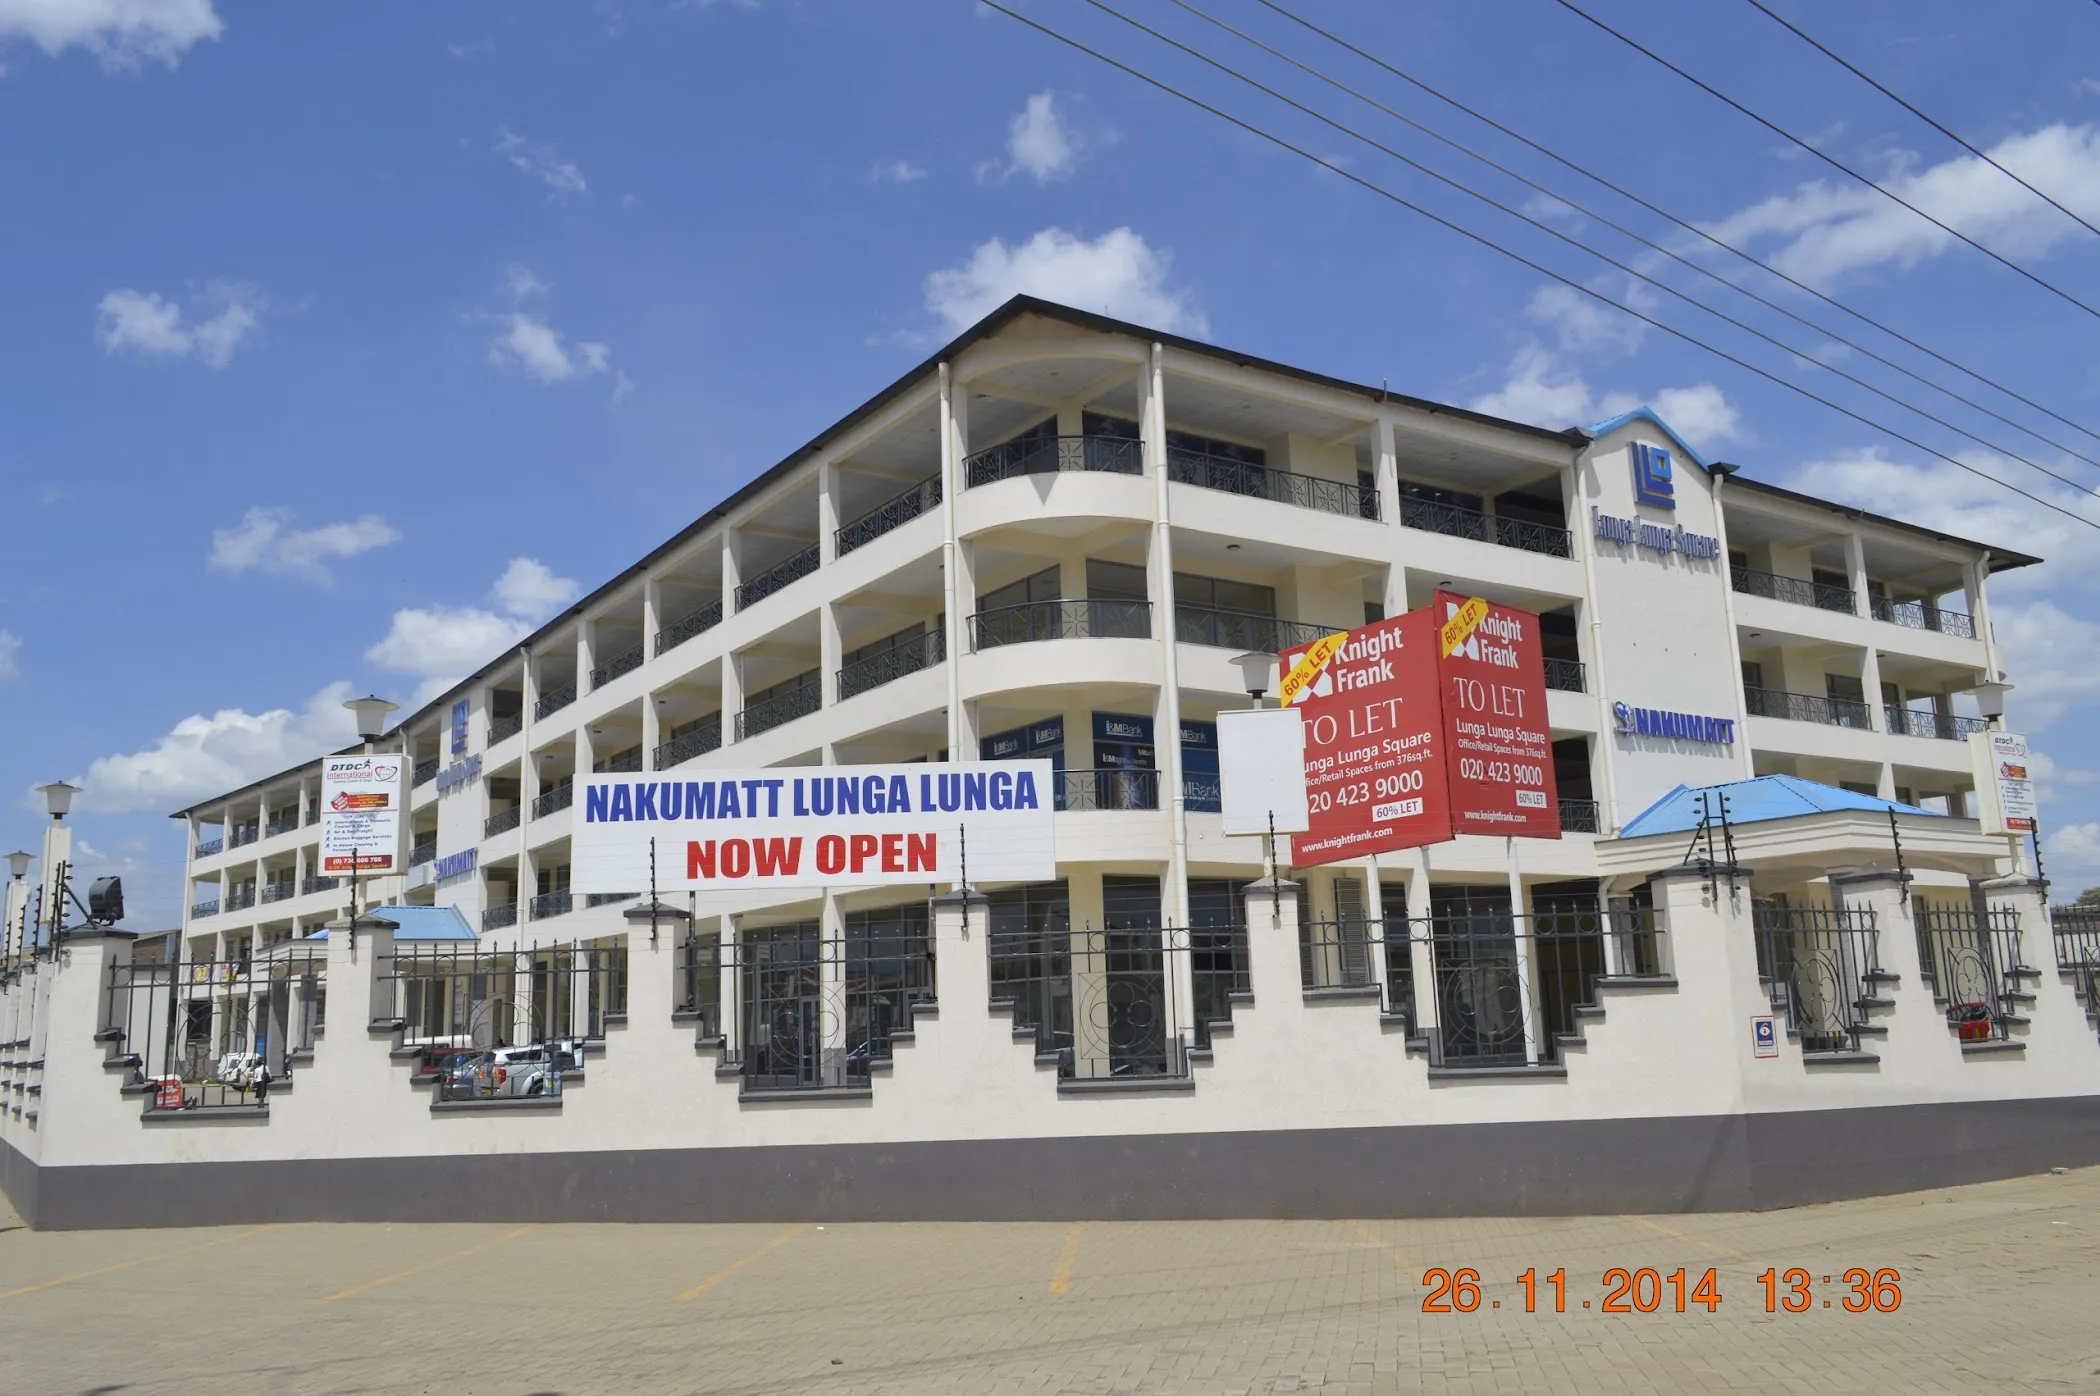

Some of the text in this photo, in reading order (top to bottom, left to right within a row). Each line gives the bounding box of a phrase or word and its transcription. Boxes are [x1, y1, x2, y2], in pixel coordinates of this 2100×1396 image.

[1591, 505, 1720, 560] Lunga Lunga Square
[1444, 603, 1477, 645] 60% LET
[1479, 612, 1523, 645] Knight
[1335, 626, 1404, 664] Knight
[1480, 638, 1519, 669] Frank
[1284, 641, 1331, 697] 60% LET
[1336, 658, 1395, 693] Frank
[1453, 677, 1526, 718] TO LET
[1123, 723, 1142, 735] Bank
[1349, 698, 1403, 738] LET
[1456, 718, 1546, 746] Lunga Lunga Square
[1634, 707, 1735, 744] NAKUMATT
[1304, 731, 1432, 773] unga Lunga Square
[1458, 738, 1493, 753] Office/Retail
[1493, 743, 1512, 755] Spaces
[1512, 745, 1525, 756] from
[331, 763, 363, 771] DTDC
[1304, 748, 1433, 787] fice/Retail Spaces from 376sq.ft.
[1460, 757, 1543, 786] 020 423 9000
[585, 771, 1039, 823] NAKUMATT LUNGA LUNGA
[1308, 769, 1423, 814] 20 423 9000
[1518, 793, 1544, 806] 60% LET
[1376, 801, 1418, 819] 60% LET
[1464, 810, 1527, 823] www.knightfrank.com
[686, 832, 937, 880] NOW OPEN
[1301, 827, 1393, 853] www.knightfrank.com
